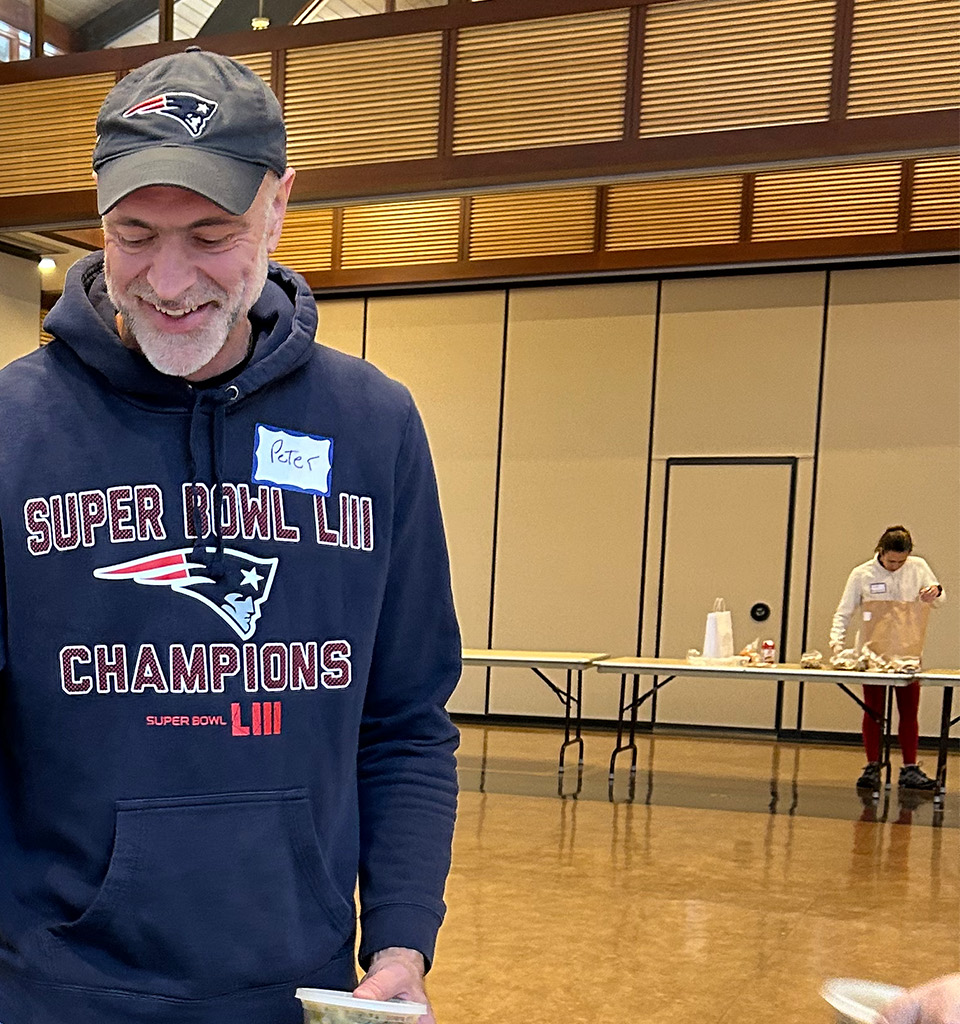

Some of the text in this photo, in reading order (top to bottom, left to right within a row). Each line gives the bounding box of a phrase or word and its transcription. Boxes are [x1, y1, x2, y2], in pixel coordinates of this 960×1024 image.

[24, 482, 374, 556] SUPER BOWL LIII
[59, 640, 352, 695] CHAMPIONS
[146, 701, 281, 737] SUPER BOWL LIII
